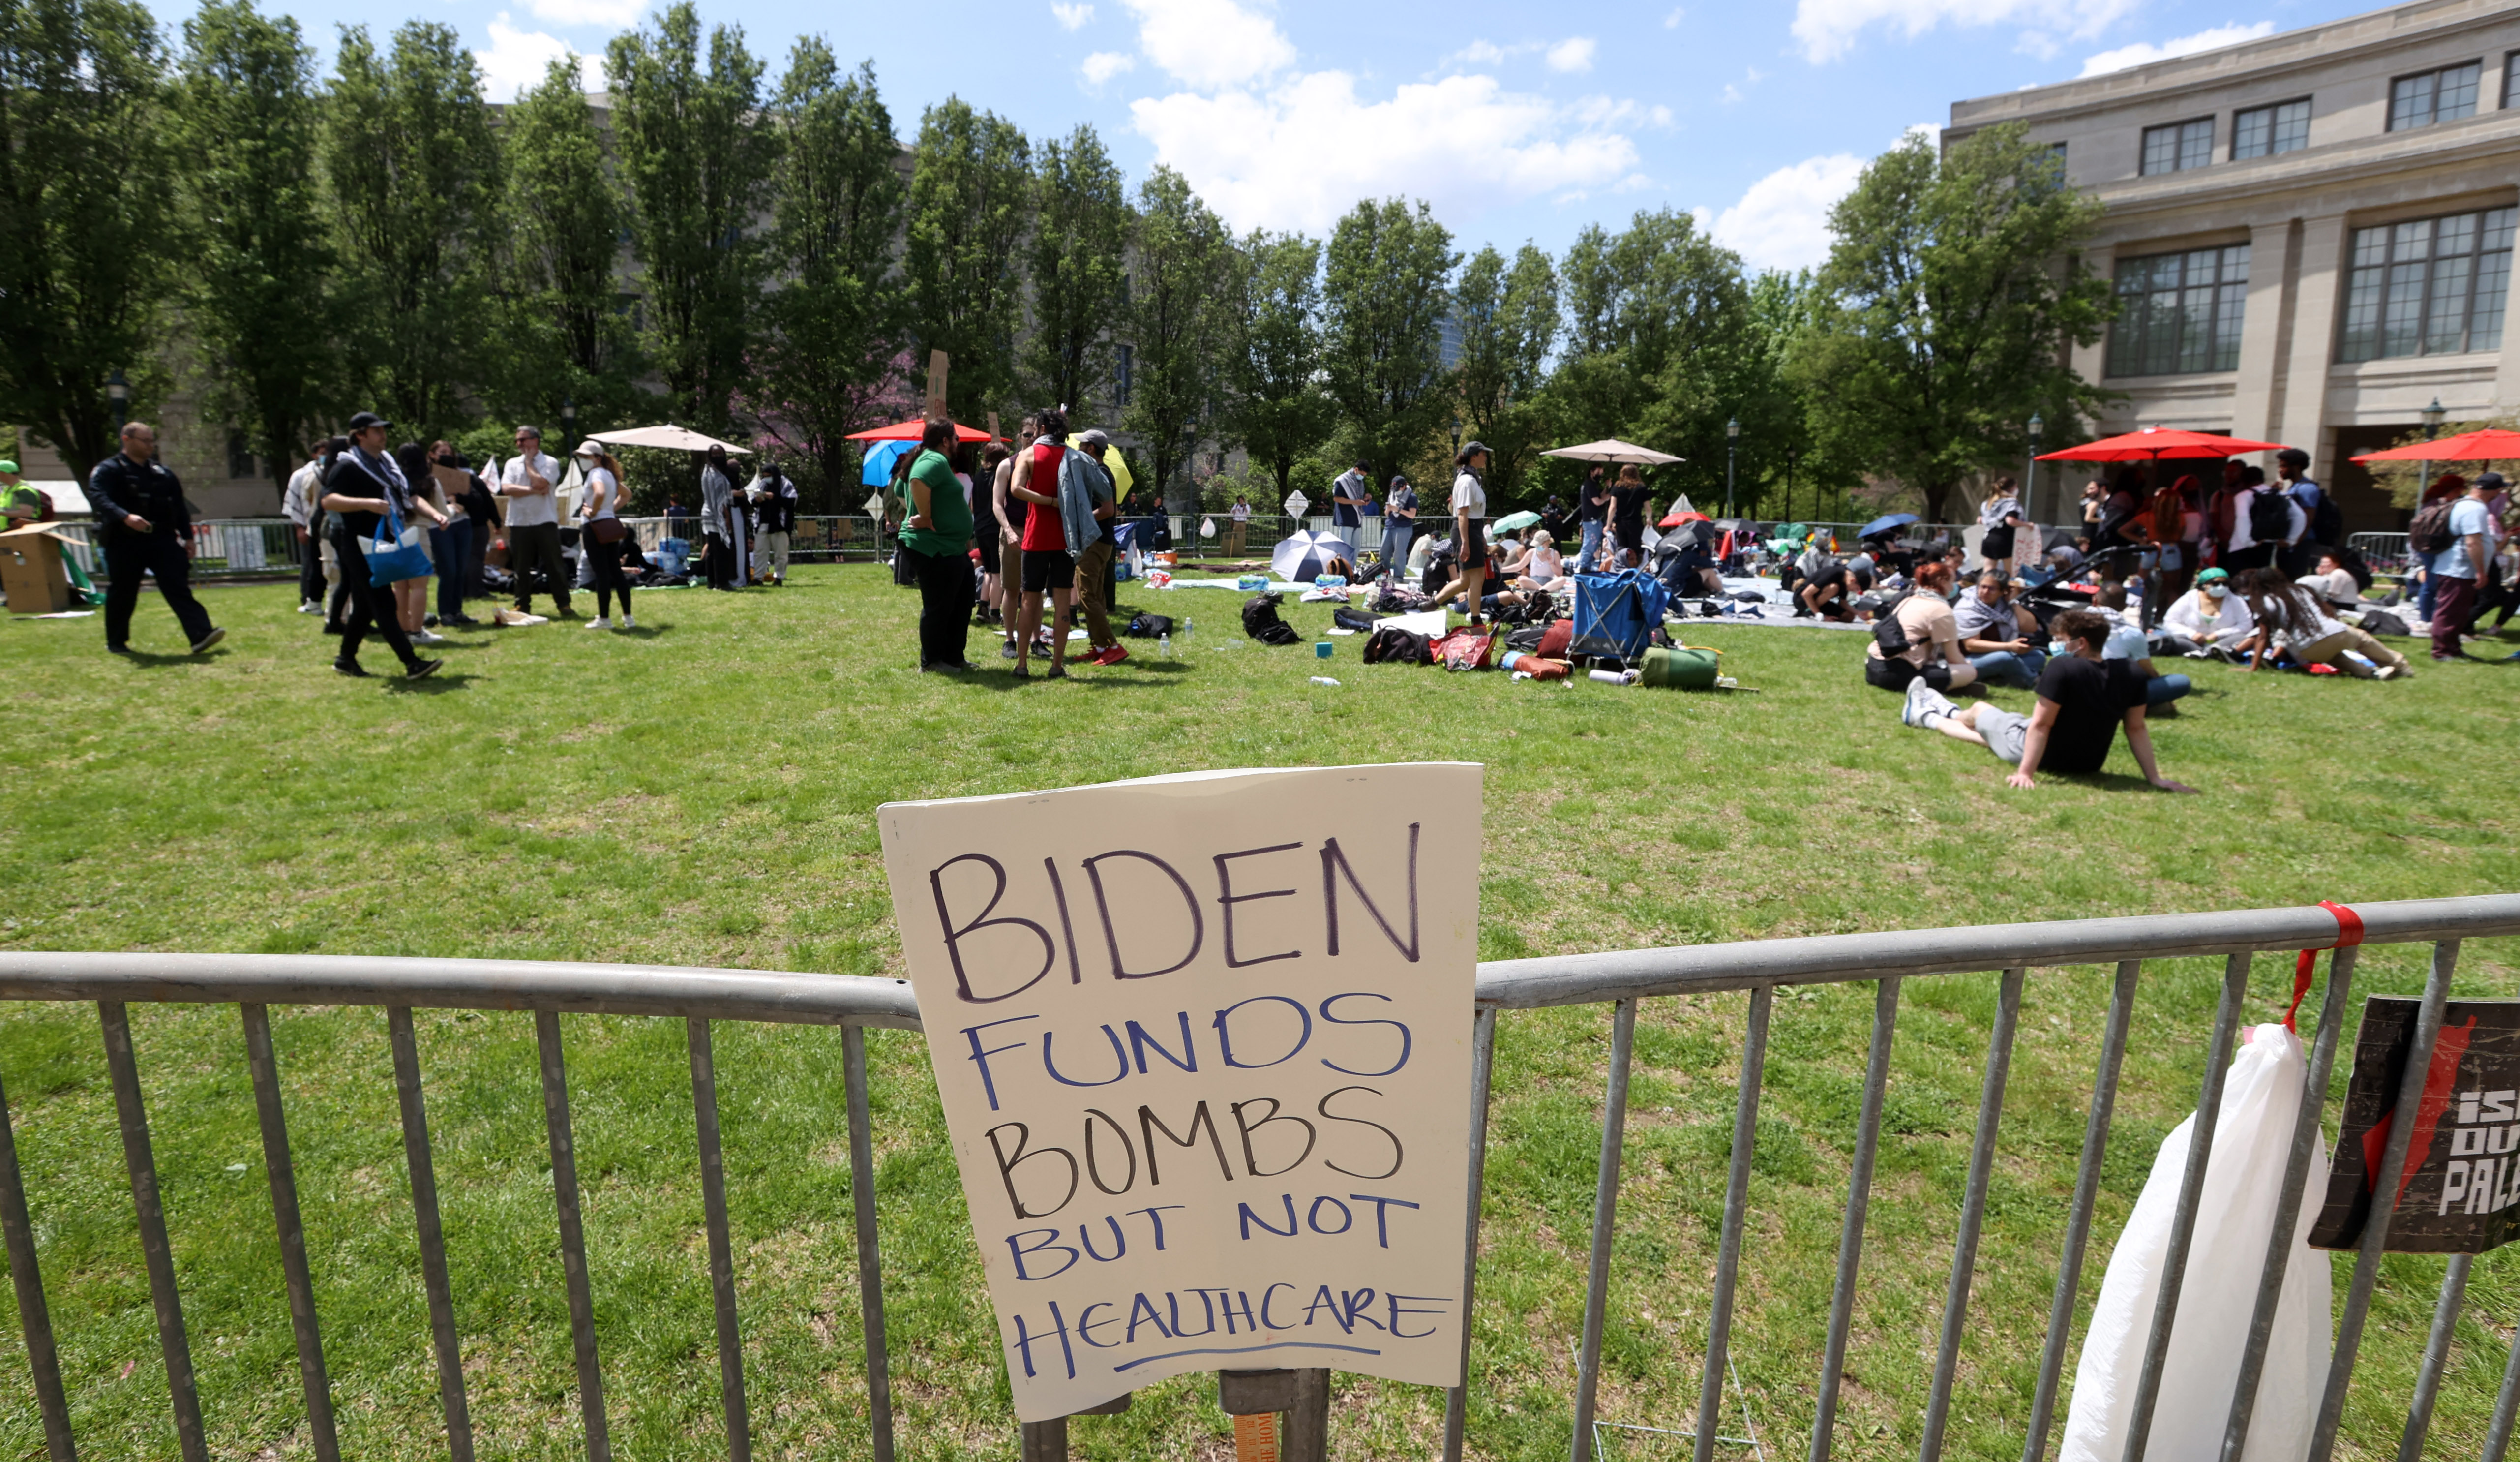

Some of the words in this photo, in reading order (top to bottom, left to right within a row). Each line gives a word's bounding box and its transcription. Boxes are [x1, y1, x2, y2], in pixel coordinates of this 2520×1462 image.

[929, 822, 1421, 1004] BIDEN
[959, 992, 1412, 1111] FUNDS
[984, 1086, 1404, 1220] BOMBS
[1004, 1205, 1186, 1281] BUT
[1237, 1193, 1420, 1249] NOT
[1013, 1282, 1454, 1380] HEALTHCARE
